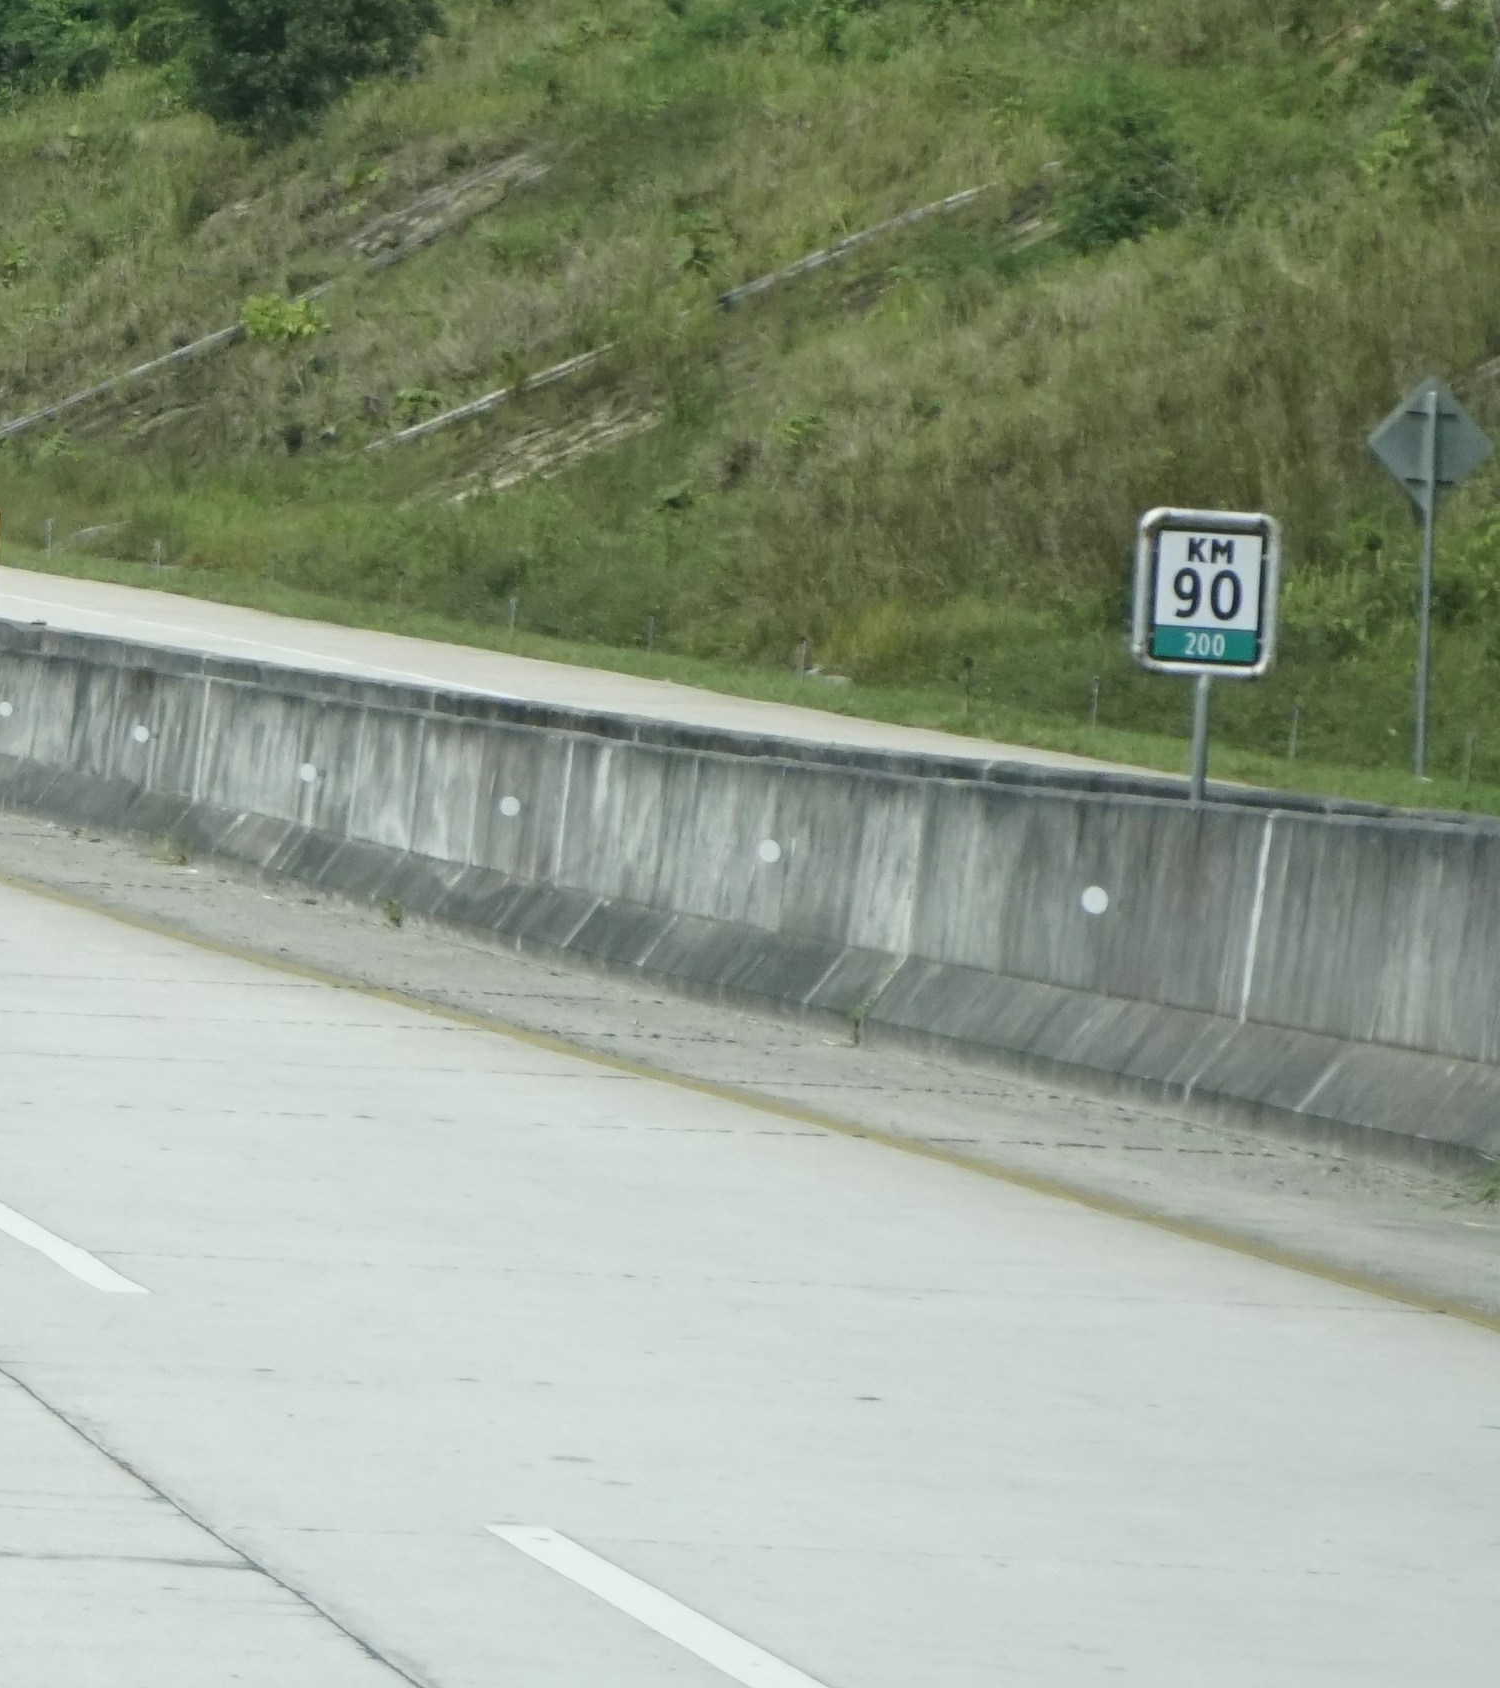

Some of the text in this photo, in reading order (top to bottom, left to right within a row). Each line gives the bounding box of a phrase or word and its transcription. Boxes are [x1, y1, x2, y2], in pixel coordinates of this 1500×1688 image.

[1187, 538, 1235, 564] KM
[1173, 568, 1243, 620] 90
[1184, 632, 1226, 657] 200
